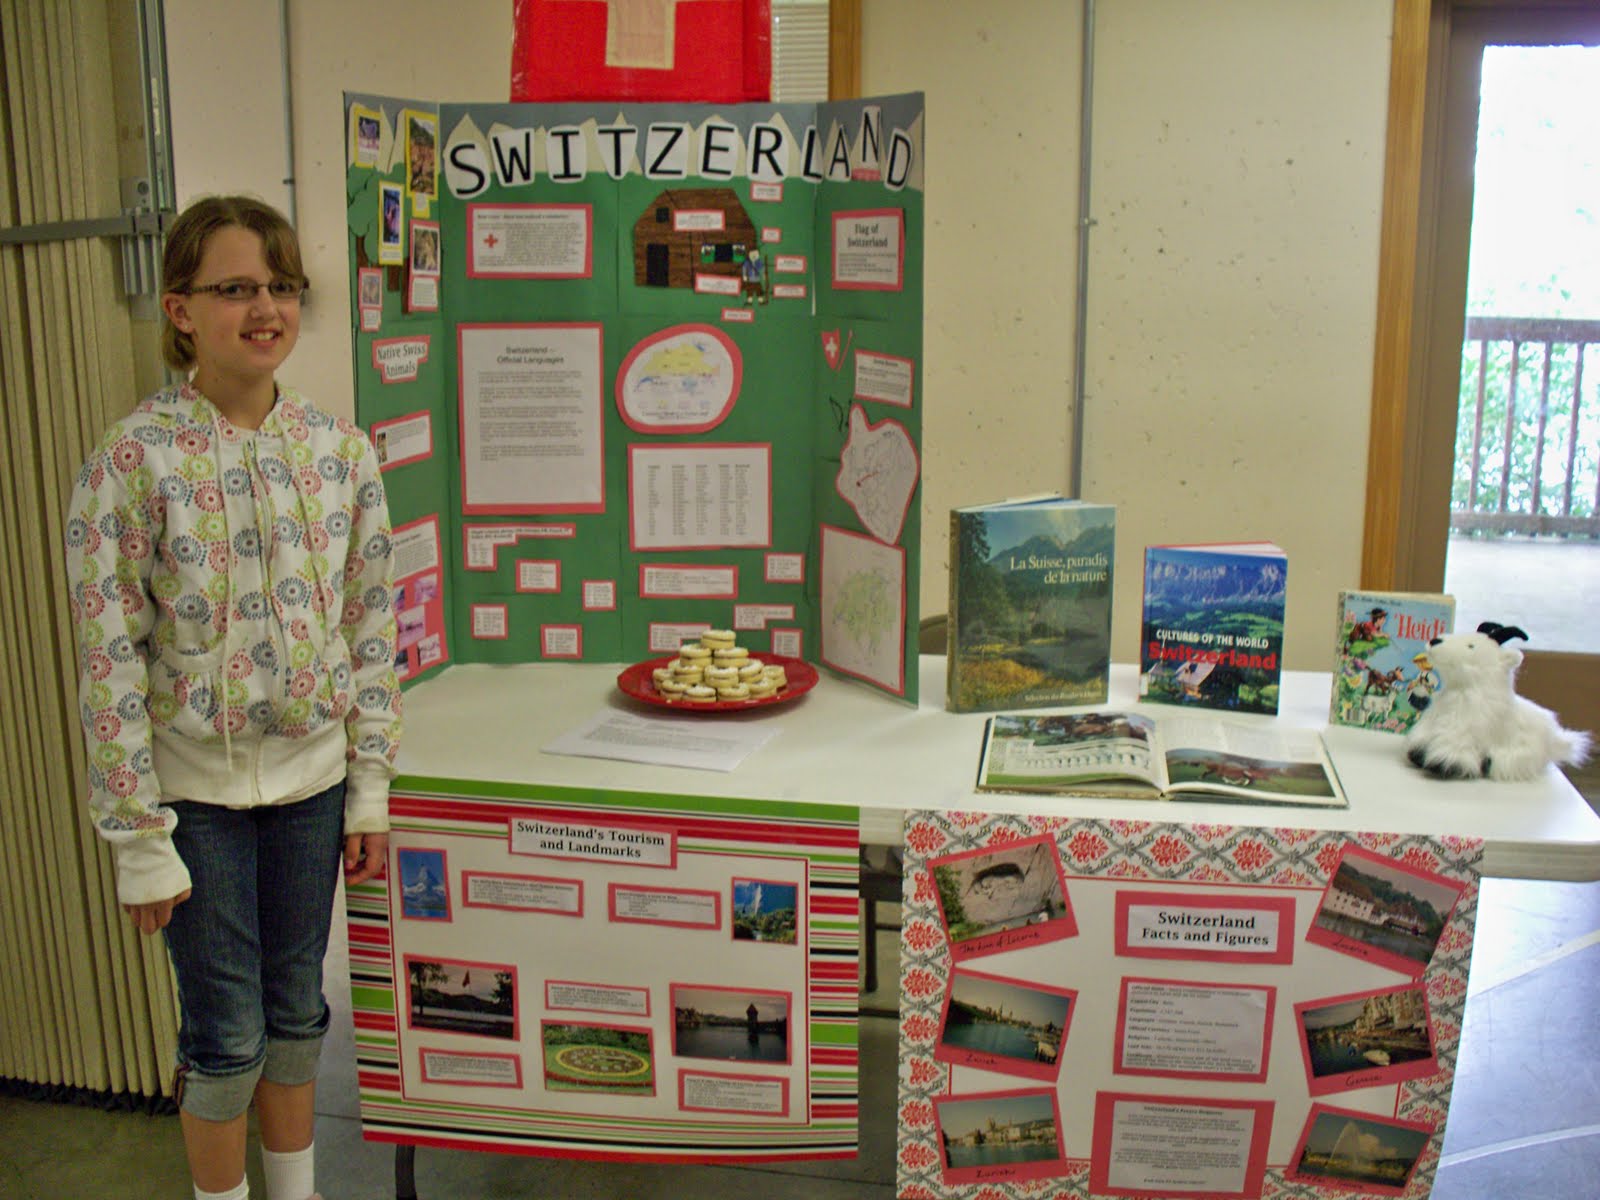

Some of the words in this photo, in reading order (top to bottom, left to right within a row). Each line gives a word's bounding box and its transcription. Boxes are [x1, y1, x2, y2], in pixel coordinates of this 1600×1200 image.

[450, 111, 911, 195] SWITZERLAND
[377, 346, 401, 360] Native
[403, 343, 426, 356] Swiss
[386, 360, 416, 377] Animals
[1010, 556, 1026, 571] La
[1067, 552, 1108, 571] paradis
[1044, 571, 1058, 584] de
[1060, 570, 1070, 584] la
[1071, 570, 1108, 583] nature
[1156, 629, 1200, 643] CULTURES
[1201, 633, 1214, 644] OF
[1216, 634, 1234, 646] THE
[1236, 637, 1269, 649] WORLD
[1148, 641, 1278, 670] Switzerland
[517, 821, 604, 840] Switzerland's
[608, 830, 665, 846] Tourism
[540, 839, 564, 851] and
[568, 841, 641, 858] Landmarks
[1158, 911, 1255, 929] Switzerland
[1142, 927, 1179, 941] Facts
[1184, 930, 1210, 943] and
[1215, 931, 1269, 947] Figures
